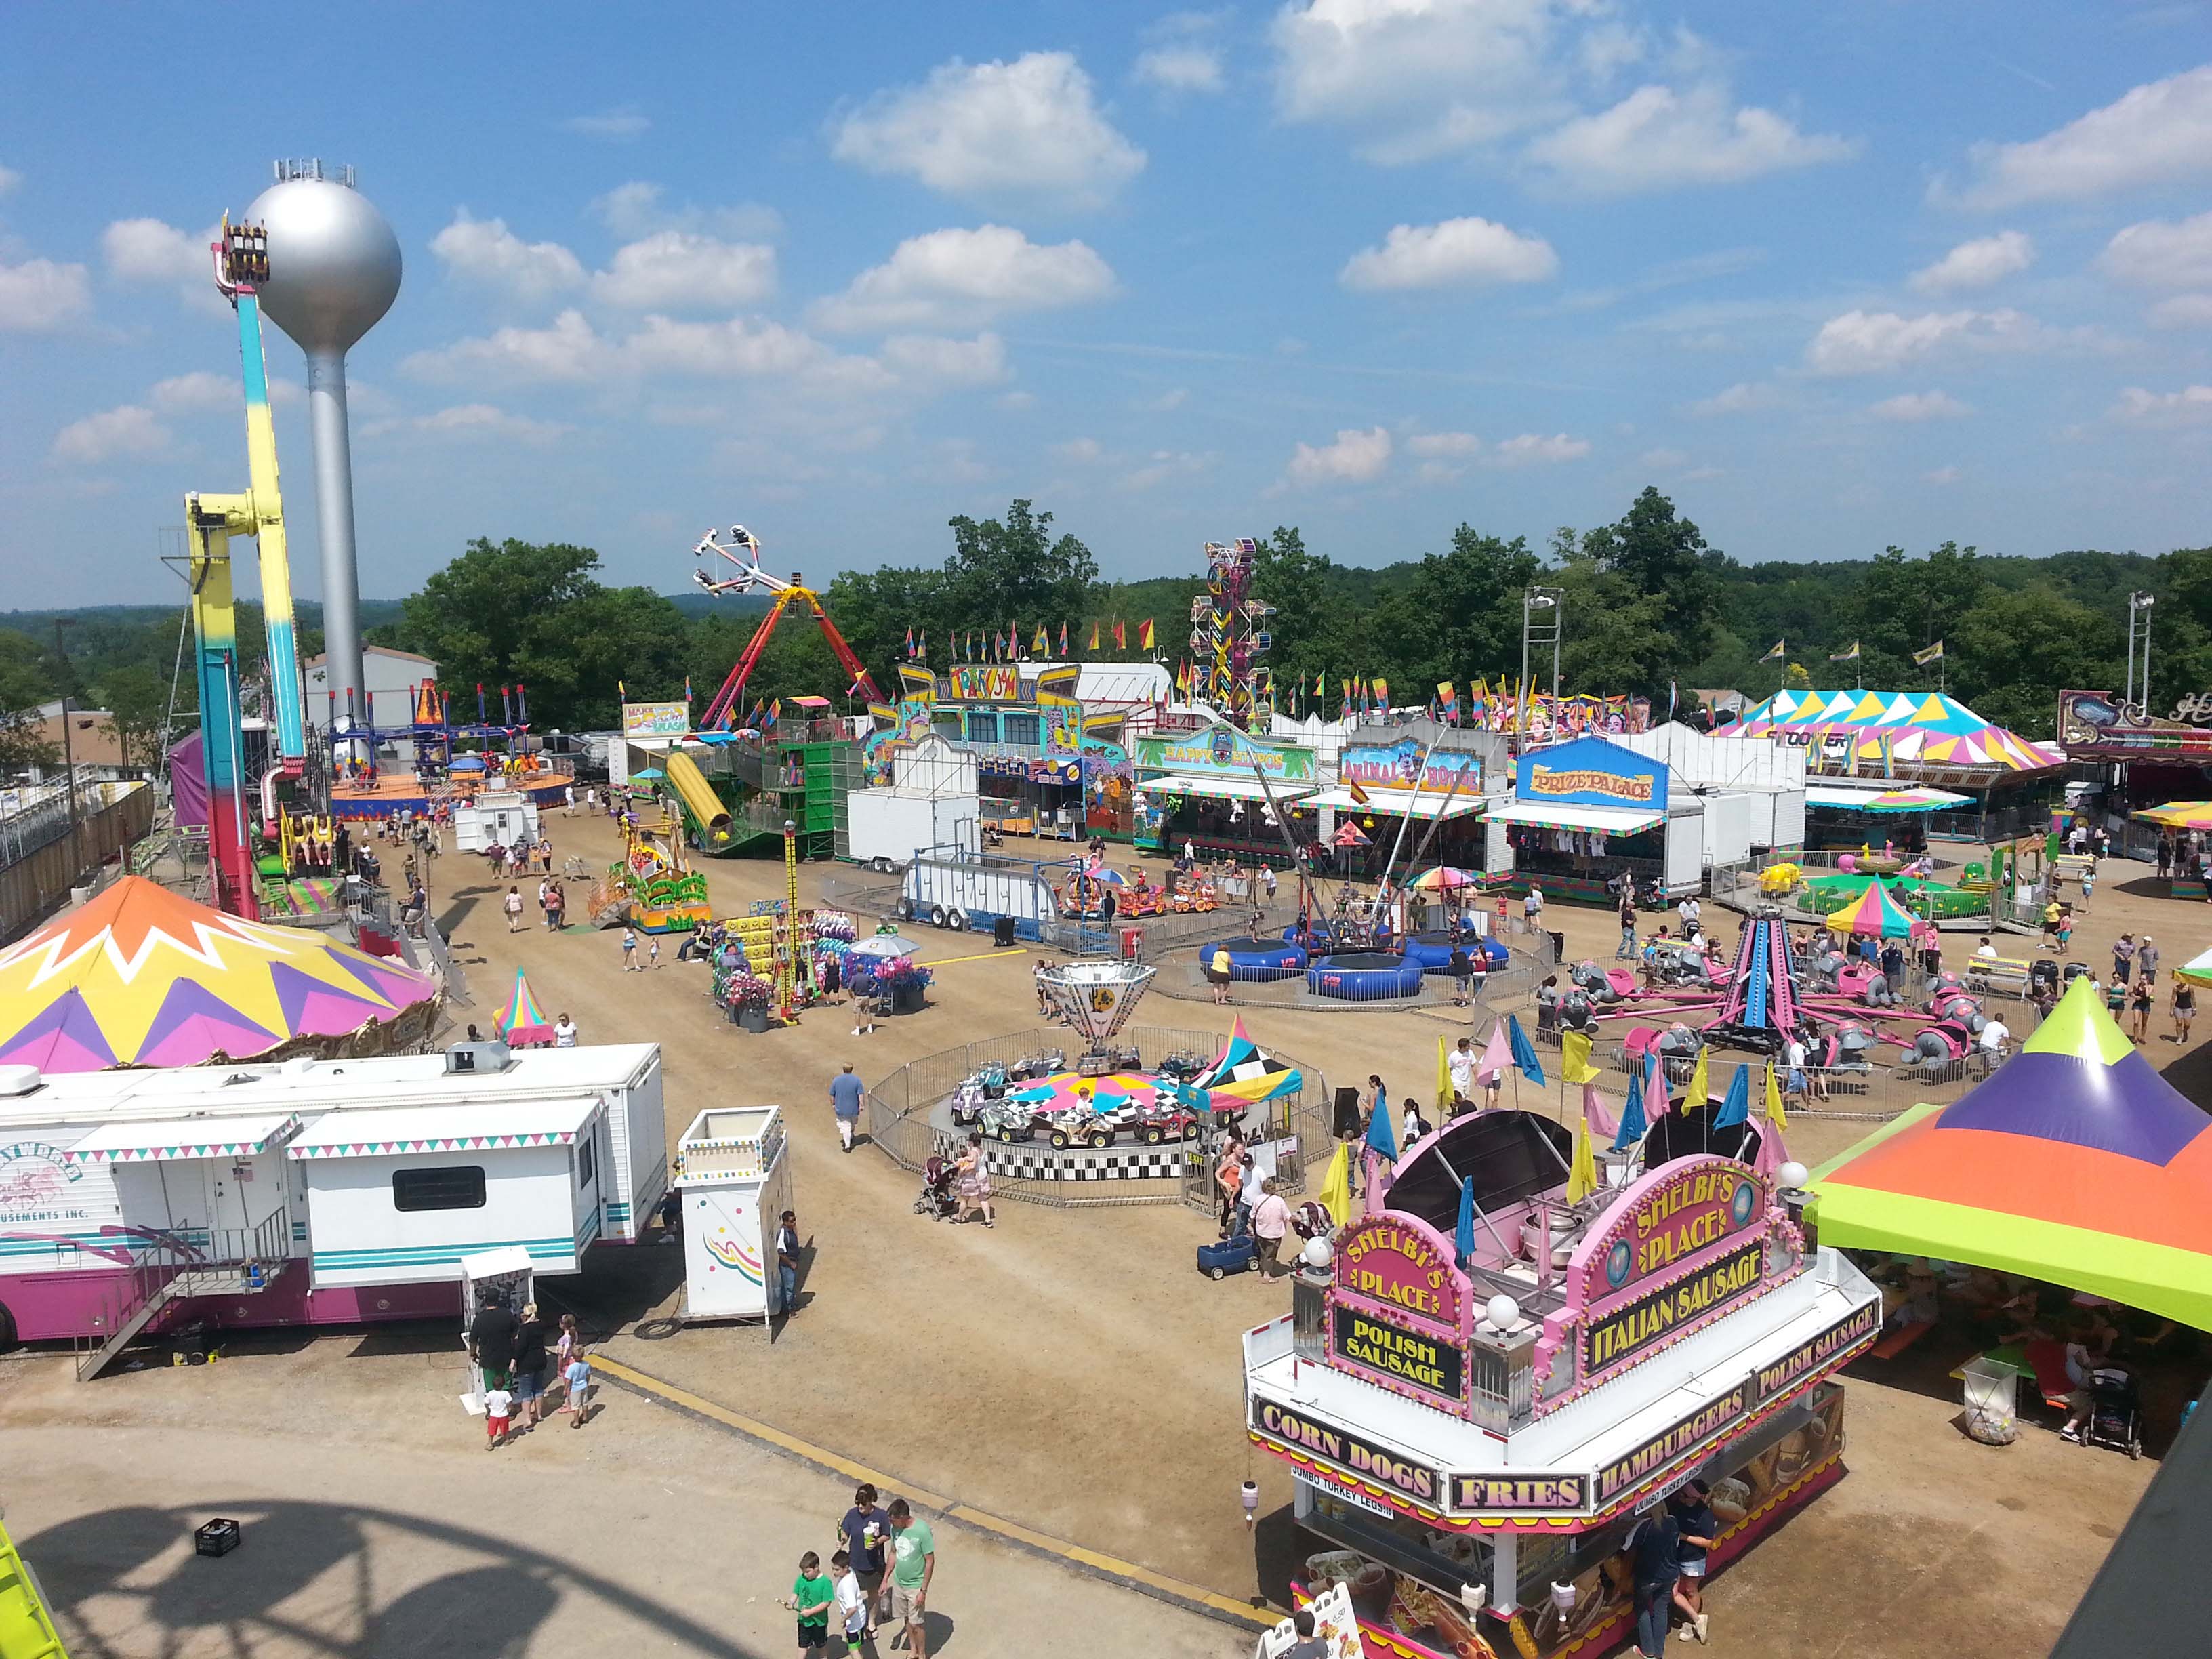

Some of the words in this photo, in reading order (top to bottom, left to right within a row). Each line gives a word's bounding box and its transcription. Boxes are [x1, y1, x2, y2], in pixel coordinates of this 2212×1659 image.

[994, 667, 1015, 697] JAM
[1164, 746, 1213, 764] HAPPY
[1344, 759, 1399, 785] ANIMAL
[1534, 774, 1586, 792] PRIZE
[1587, 774, 1652, 798] PALACE
[1189, 1152, 1204, 1164] EXIT
[66, 1210, 89, 1219] INC.
[1637, 1173, 1734, 1239] SHELBI'S
[1347, 1229, 1443, 1289] SHELBI'S
[1649, 1210, 1718, 1269] PLACE
[1361, 1270, 1429, 1313] PLACE
[1594, 1294, 1673, 1364] ITALIAN
[1677, 1249, 1761, 1319] SAUSAGE
[1347, 1338, 1445, 1389] SAUSAGE
[1354, 1319, 1437, 1366] POLISH
[1759, 1345, 1813, 1398] POLISH
[1815, 1304, 1874, 1362] SAUSAGE
[1263, 1404, 1343, 1459] CORN
[1349, 1441, 1433, 1498] DOGS
[1601, 1388, 1742, 1498] HAMBURGERS
[1292, 1466, 1321, 1486] JUMBO
[1324, 1476, 1357, 1502] TURKEY
[1459, 1479, 1580, 1507] FRIES
[1637, 1492, 1660, 1512] JUMBO
[1662, 1478, 1684, 1498] TURKEY
